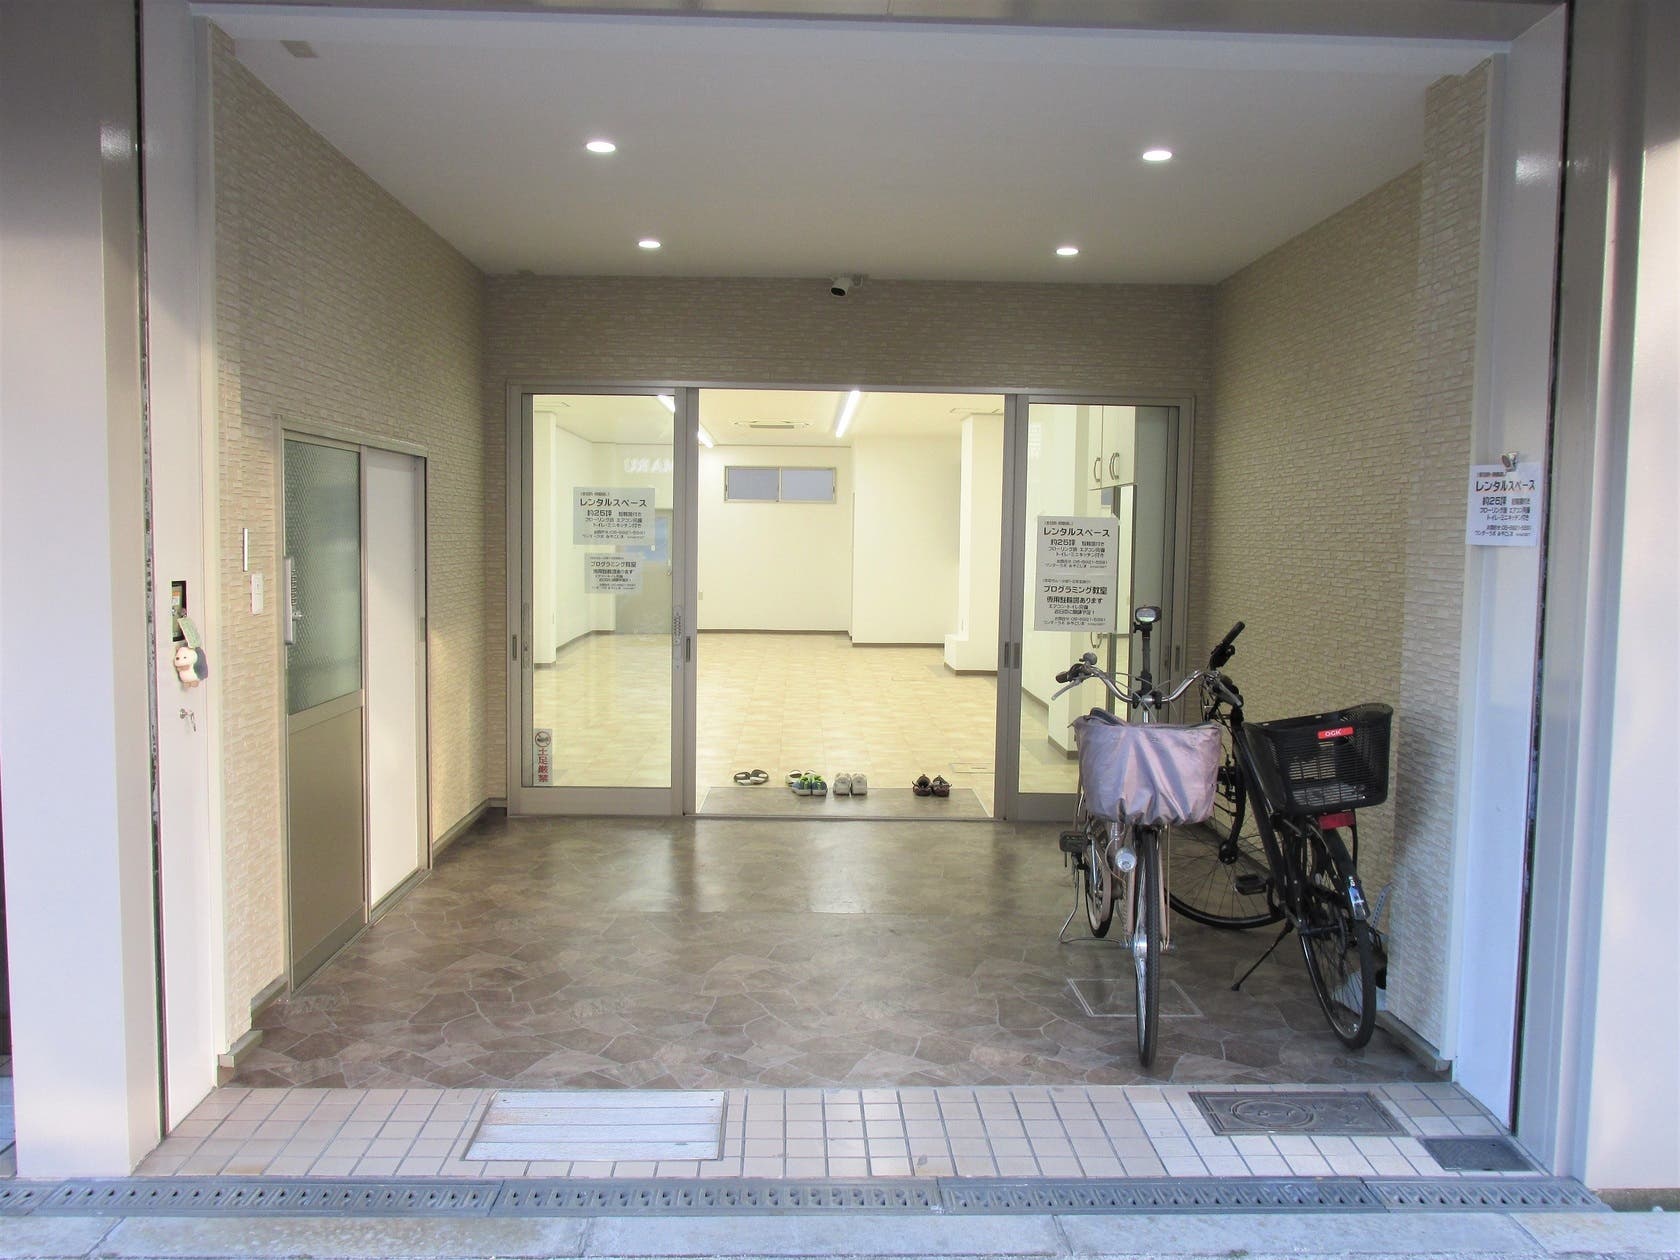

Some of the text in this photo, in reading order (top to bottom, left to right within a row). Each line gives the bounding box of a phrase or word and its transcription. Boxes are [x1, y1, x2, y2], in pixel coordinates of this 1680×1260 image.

[1475, 480, 1536, 492] レンタルスペース
[580, 498, 648, 507] レンタルスペース
[1043, 527, 1111, 538] レンタルスペース
[1043, 585, 1108, 595] プログラミング教室
[1324, 728, 1343, 737] OGK
[537, 748, 548, 782] 土足厳禁
